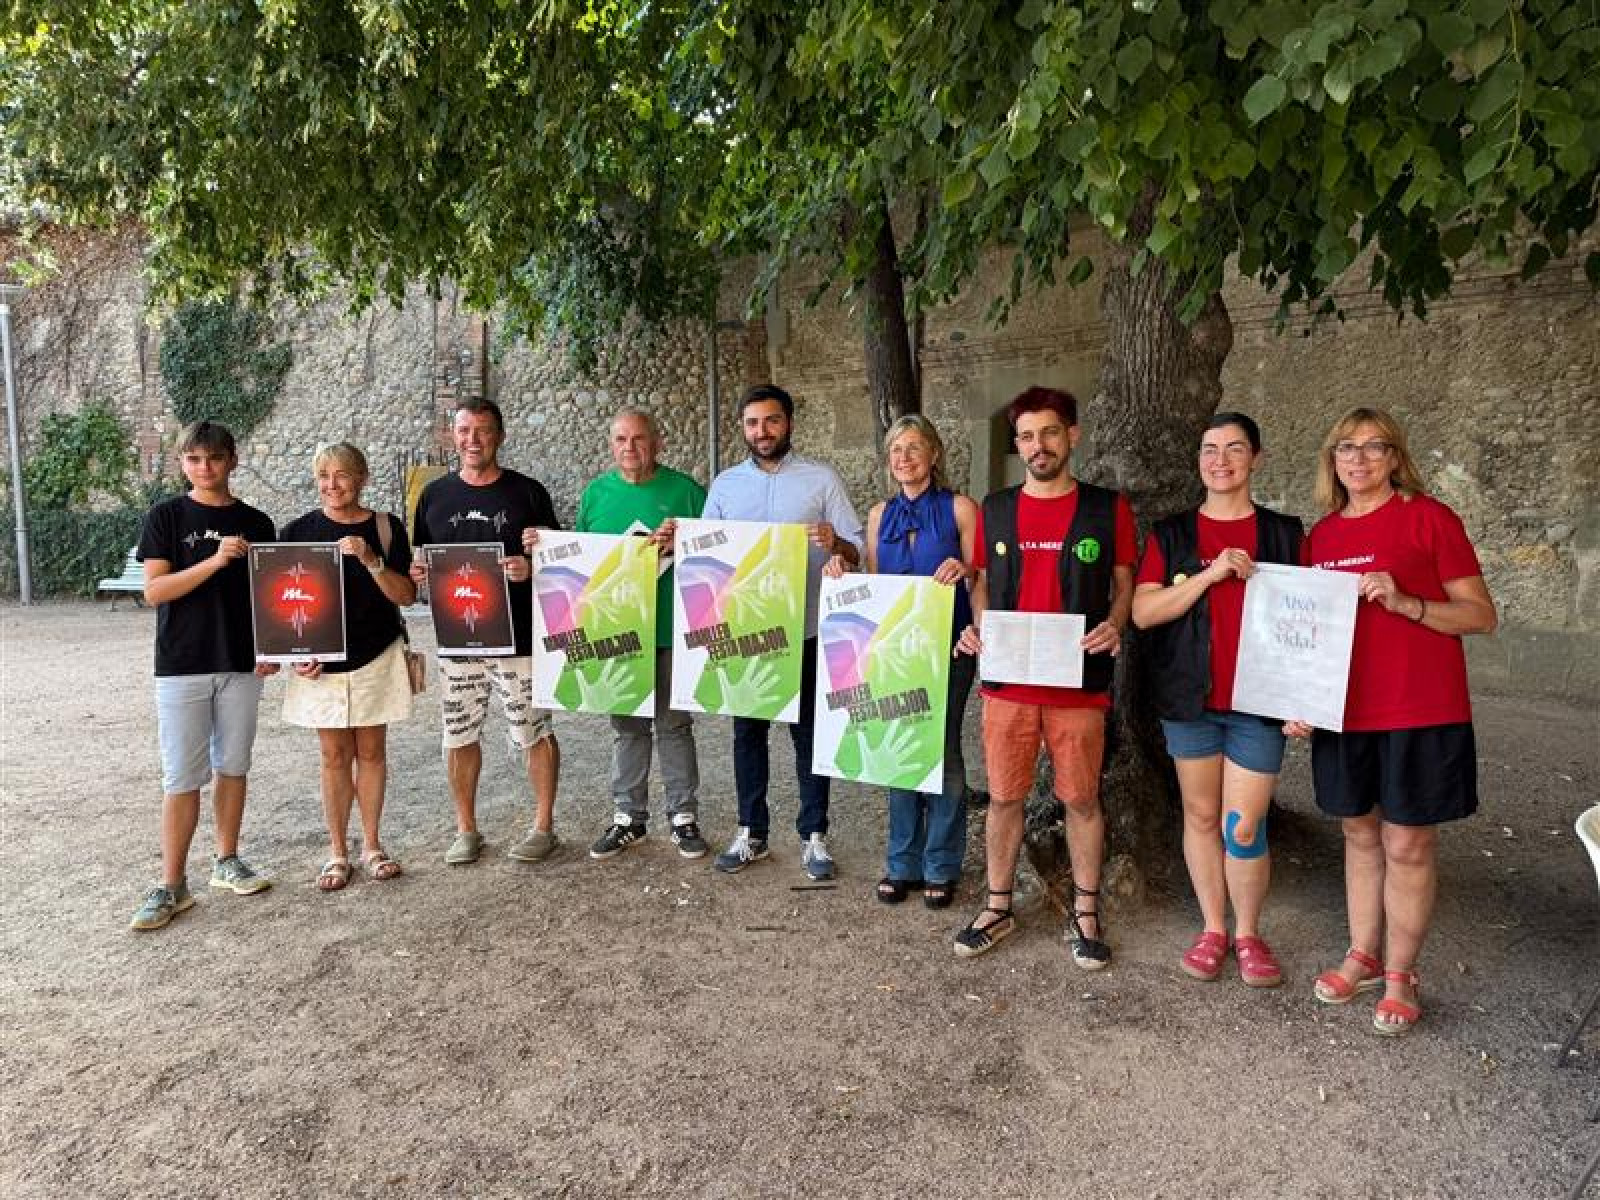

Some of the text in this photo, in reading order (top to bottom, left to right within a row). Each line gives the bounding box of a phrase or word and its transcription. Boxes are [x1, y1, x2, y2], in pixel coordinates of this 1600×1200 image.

[594, 630, 642, 660] MAJOR
[737, 626, 789, 658] MAJOR
[878, 687, 931, 722] MAJOR
